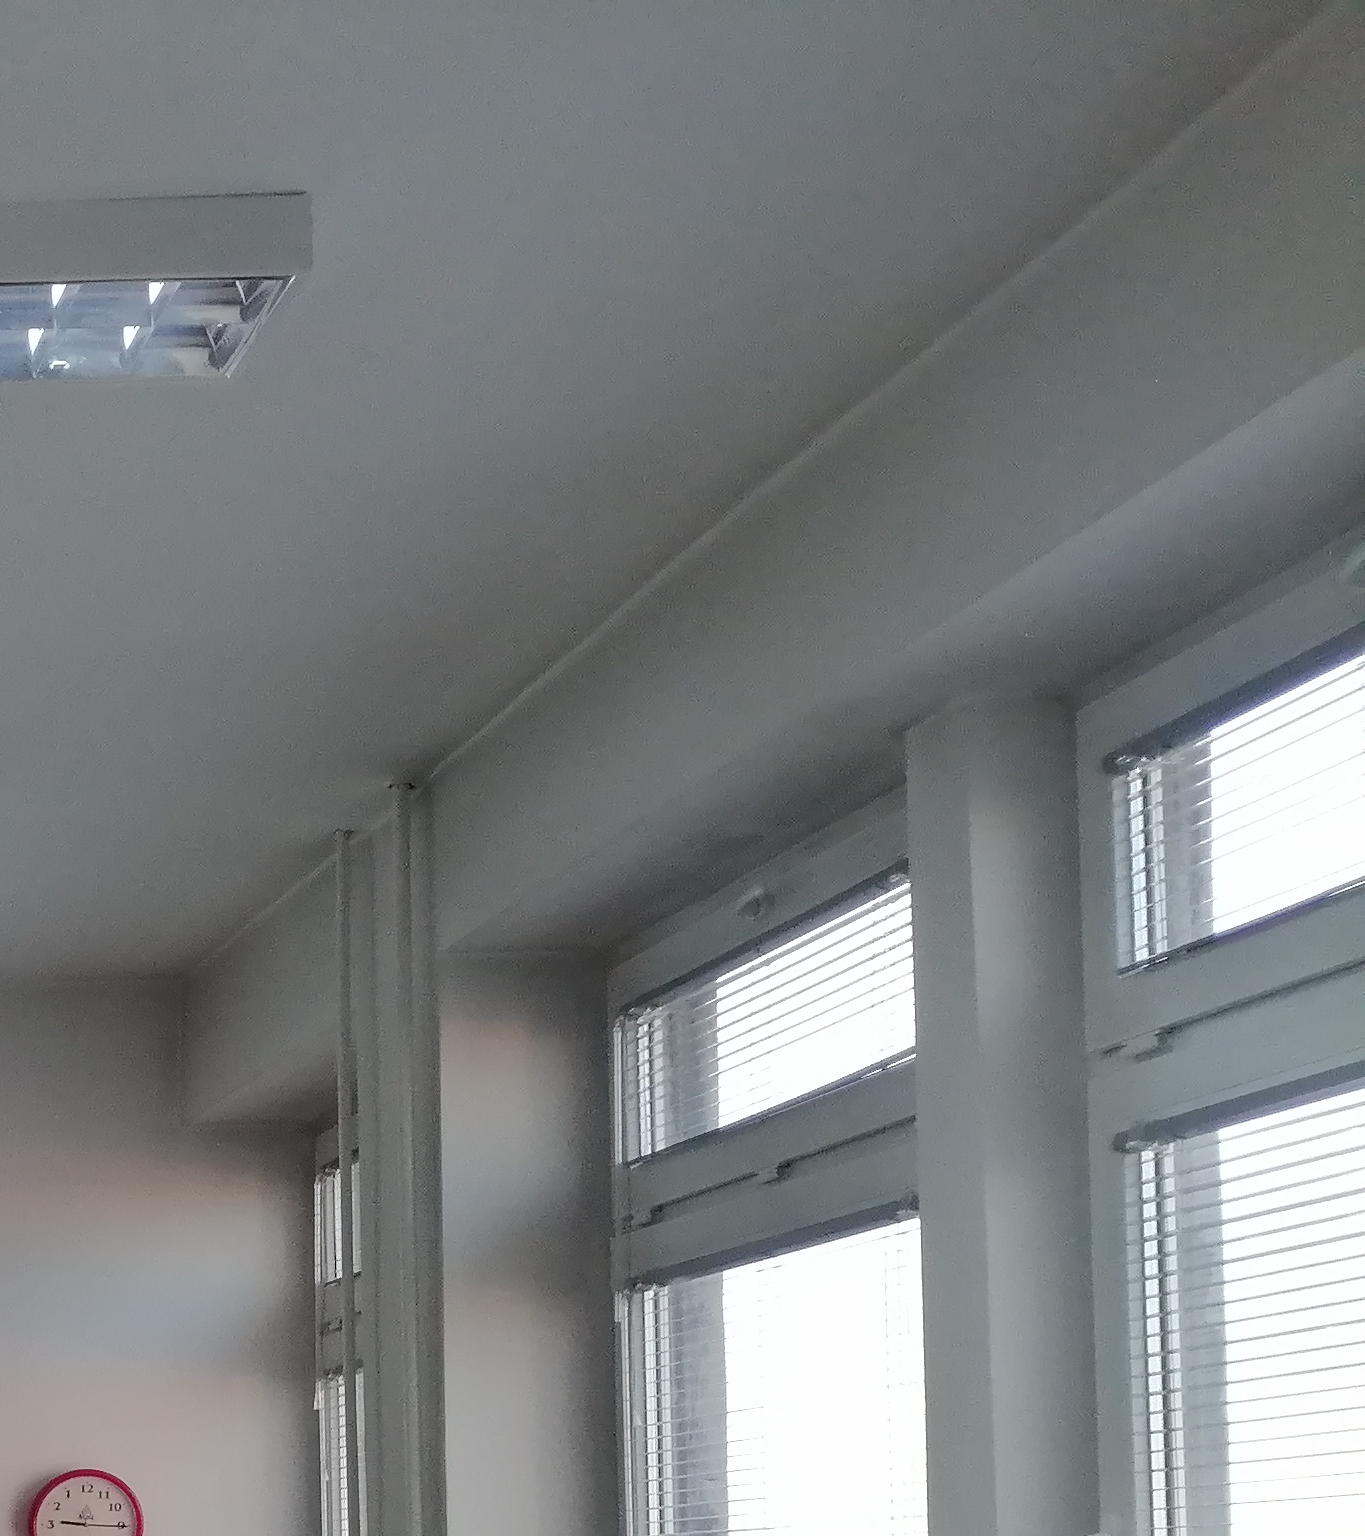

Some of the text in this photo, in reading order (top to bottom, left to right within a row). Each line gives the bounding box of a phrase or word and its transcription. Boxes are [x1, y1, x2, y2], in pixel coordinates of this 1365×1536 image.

[80, 1483, 94, 1493] 12
[65, 1489, 71, 1499] 1
[98, 1490, 110, 1499] 11
[53, 1501, 61, 1511] 2
[108, 1502, 122, 1512] 10
[47, 1520, 55, 1529] 3
